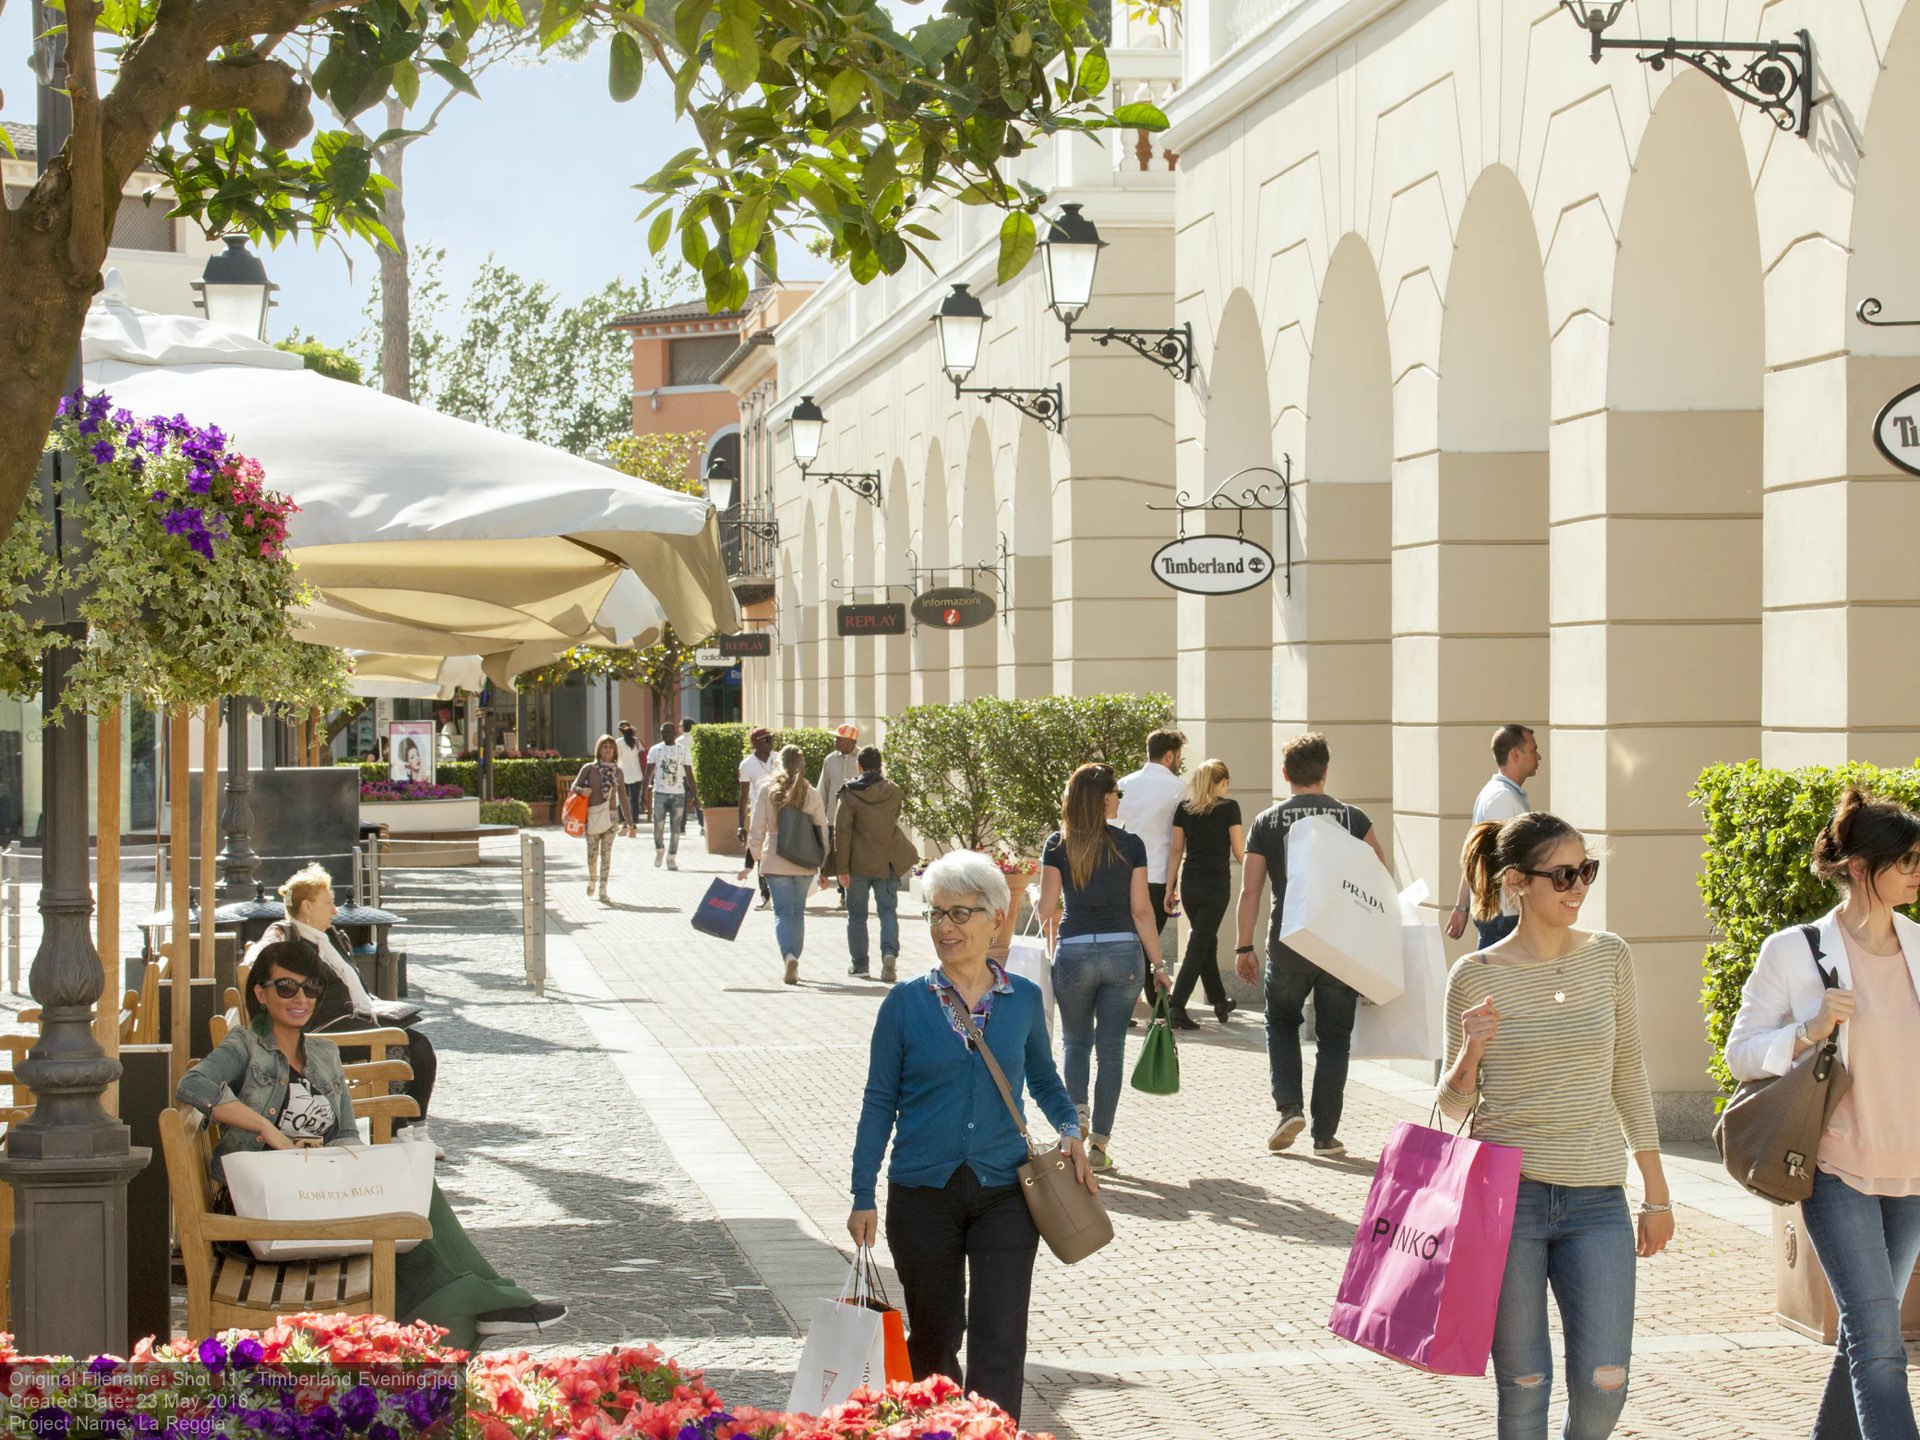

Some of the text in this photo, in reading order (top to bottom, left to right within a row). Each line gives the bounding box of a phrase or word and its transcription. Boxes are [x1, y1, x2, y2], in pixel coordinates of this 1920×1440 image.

[1162, 557, 1244, 574] Timberland
[922, 596, 981, 607] Informazioni
[845, 615, 897, 628] REPLAY
[725, 641, 765, 651] REPLAY
[1342, 879, 1385, 913] PRADA
[298, 1184, 384, 1200] ROBERTA BIAGI
[1371, 1217, 1439, 1261] PINKO
